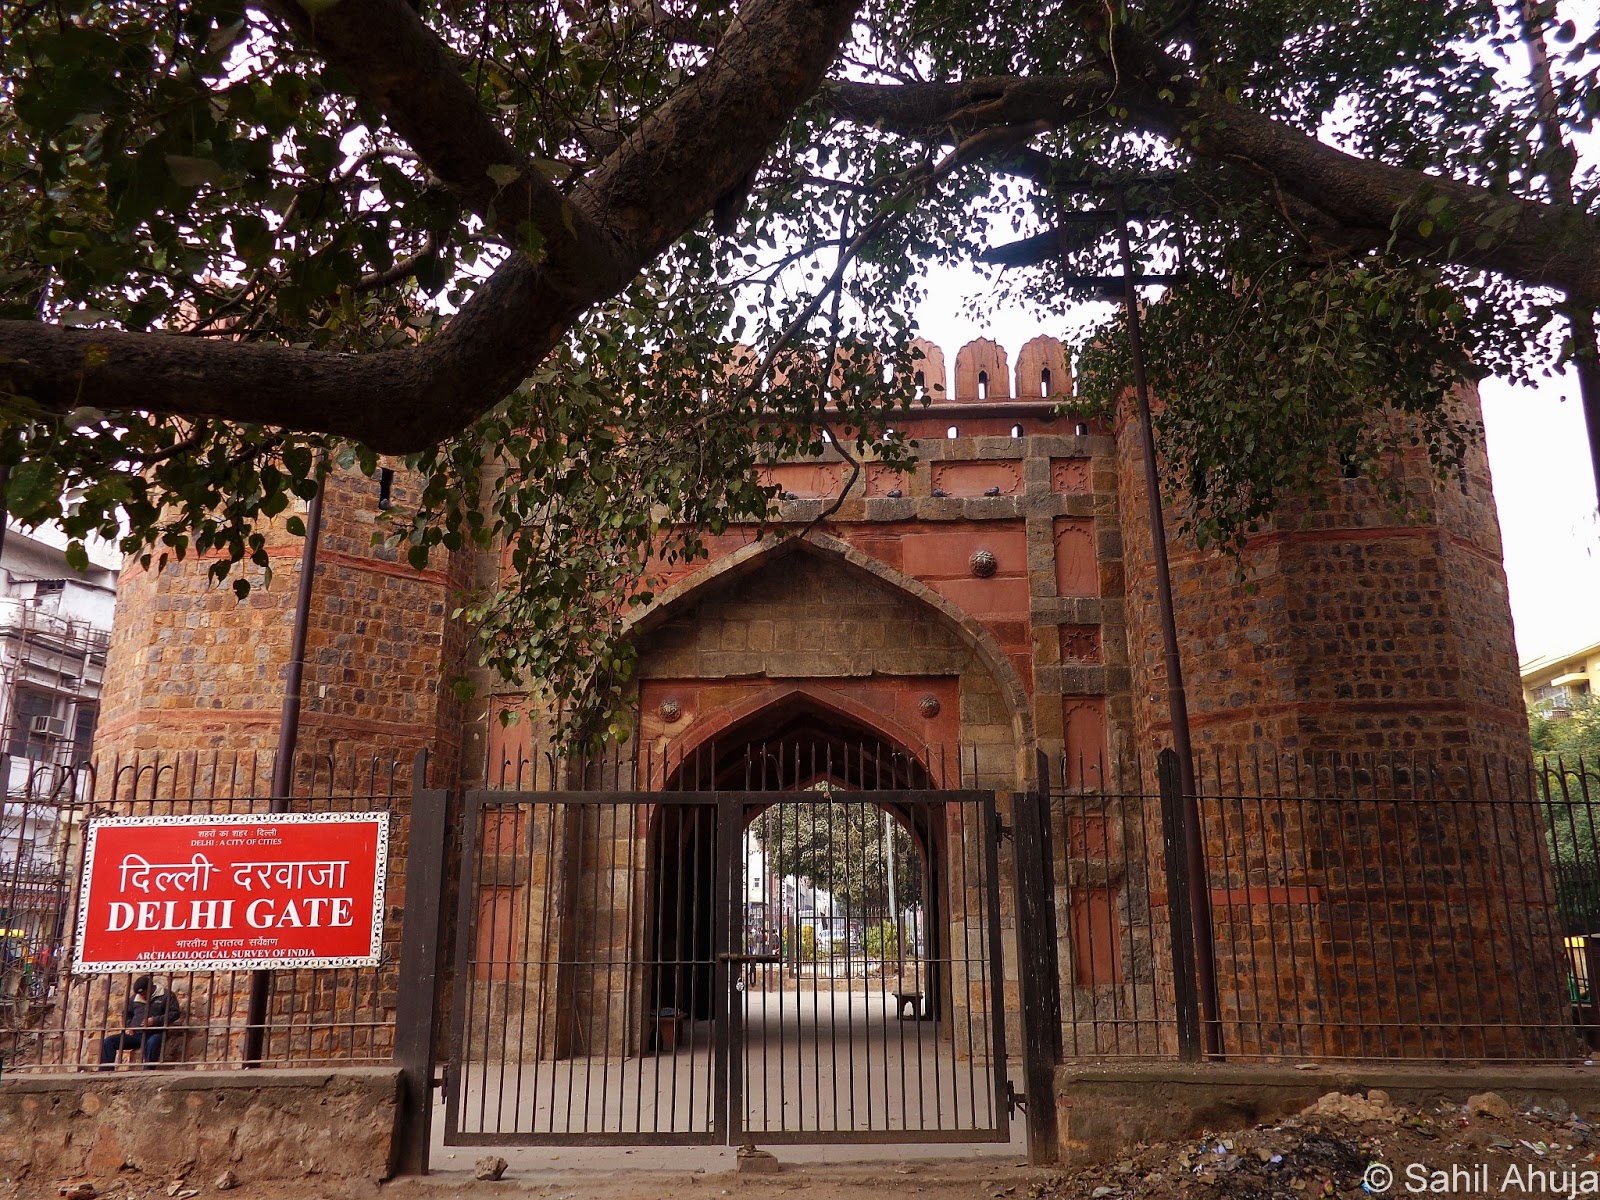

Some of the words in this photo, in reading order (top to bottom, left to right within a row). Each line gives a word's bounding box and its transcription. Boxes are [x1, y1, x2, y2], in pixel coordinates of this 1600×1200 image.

[256, 828, 277, 837] दिल्ली
[119, 853, 214, 893] दिल्ली
[231, 860, 350, 892] दरवाजा
[105, 899, 236, 932] DELHI
[246, 897, 353, 929] GATE
[176, 937, 208, 948] भारतीय
[212, 938, 244, 950] पुरातत्व
[248, 936, 279, 947] सर्वेक्षण
[136, 950, 230, 960] ARCHAEOLOGICAL
[231, 949, 271, 959] SURVEY
[272, 949, 286, 957] OF
[287, 948, 316, 957] INDIA
